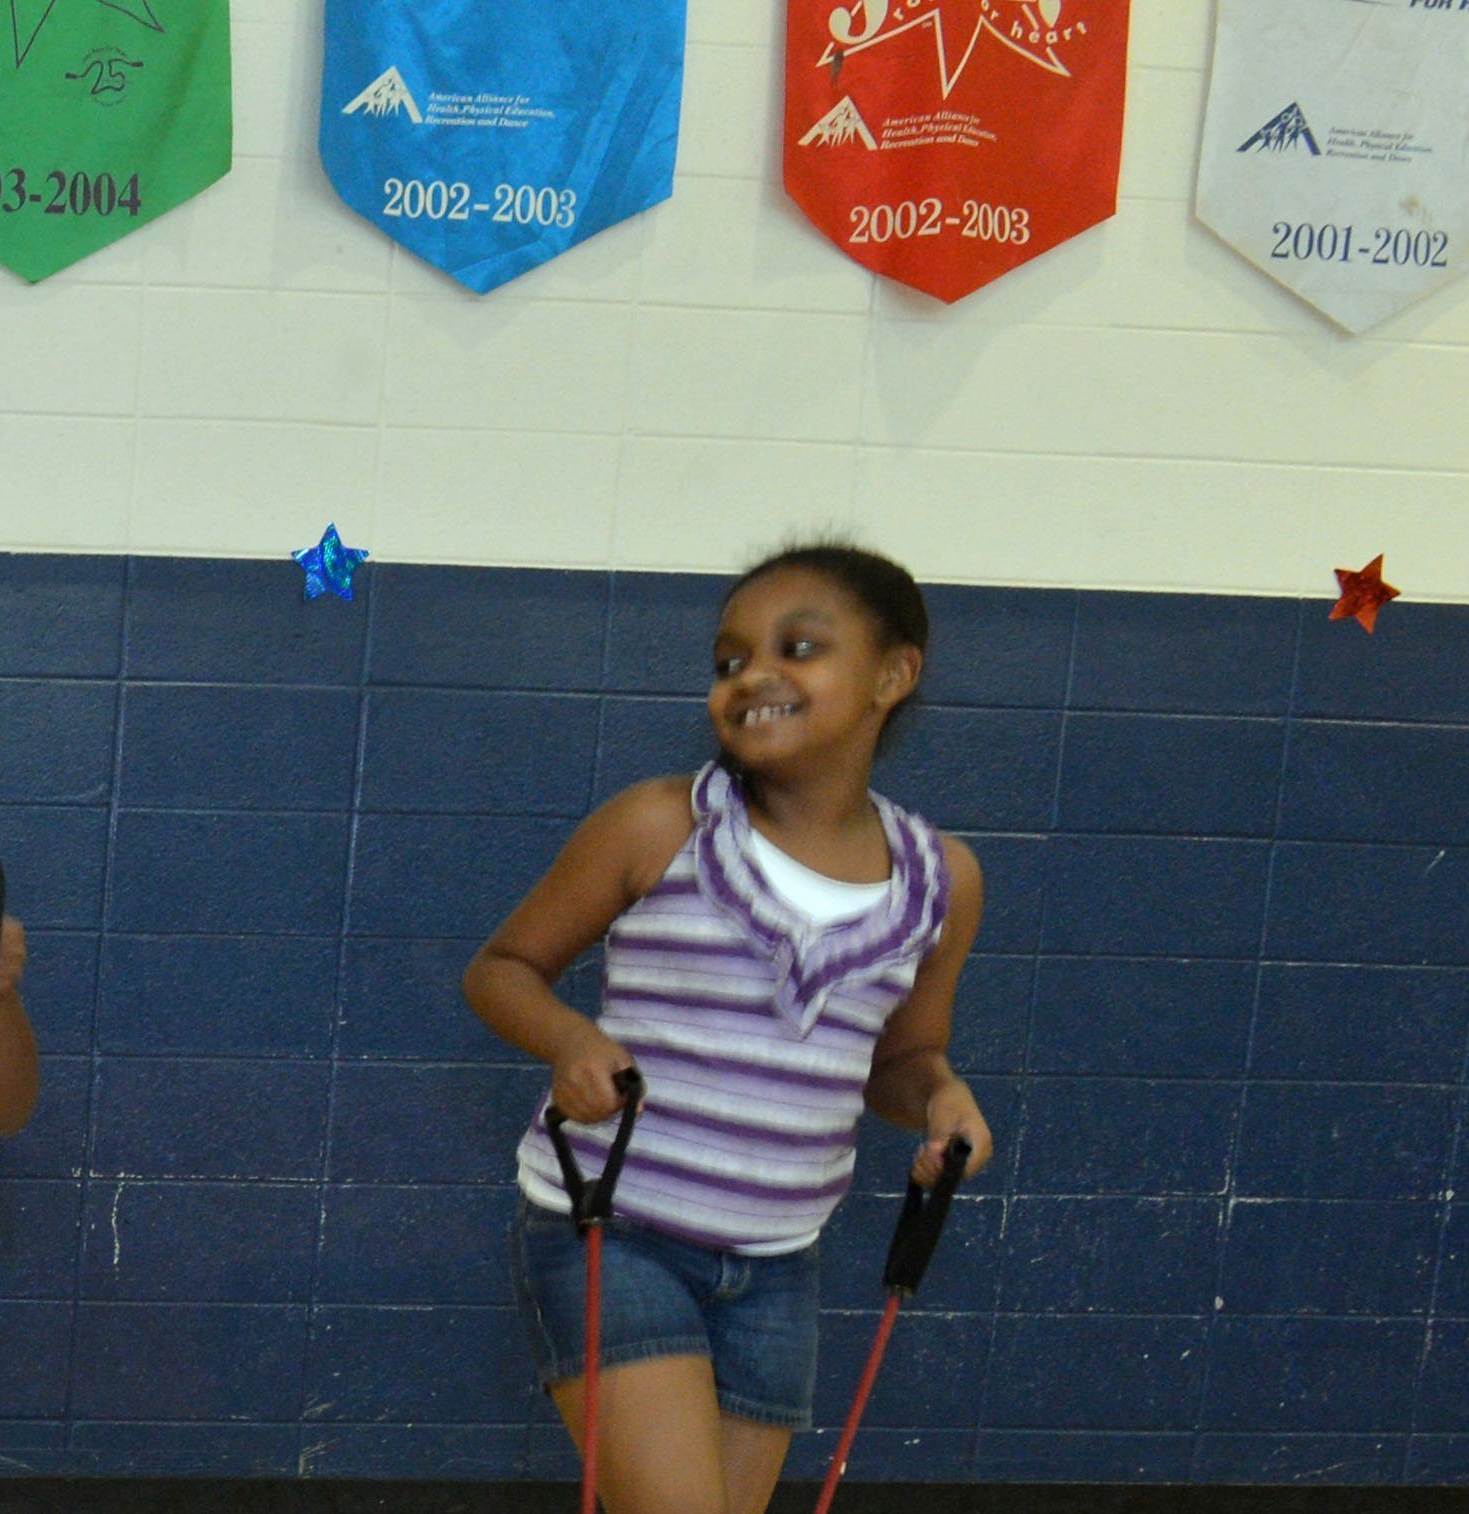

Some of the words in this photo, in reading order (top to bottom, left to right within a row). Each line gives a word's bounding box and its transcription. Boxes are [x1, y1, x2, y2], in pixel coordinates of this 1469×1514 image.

[1010, 20, 1087, 45] heart
[383, 177, 577, 228] 2002-2003
[848, 197, 1030, 245] 2002-2003
[1270, 221, 1449, 268] 2001-2002
